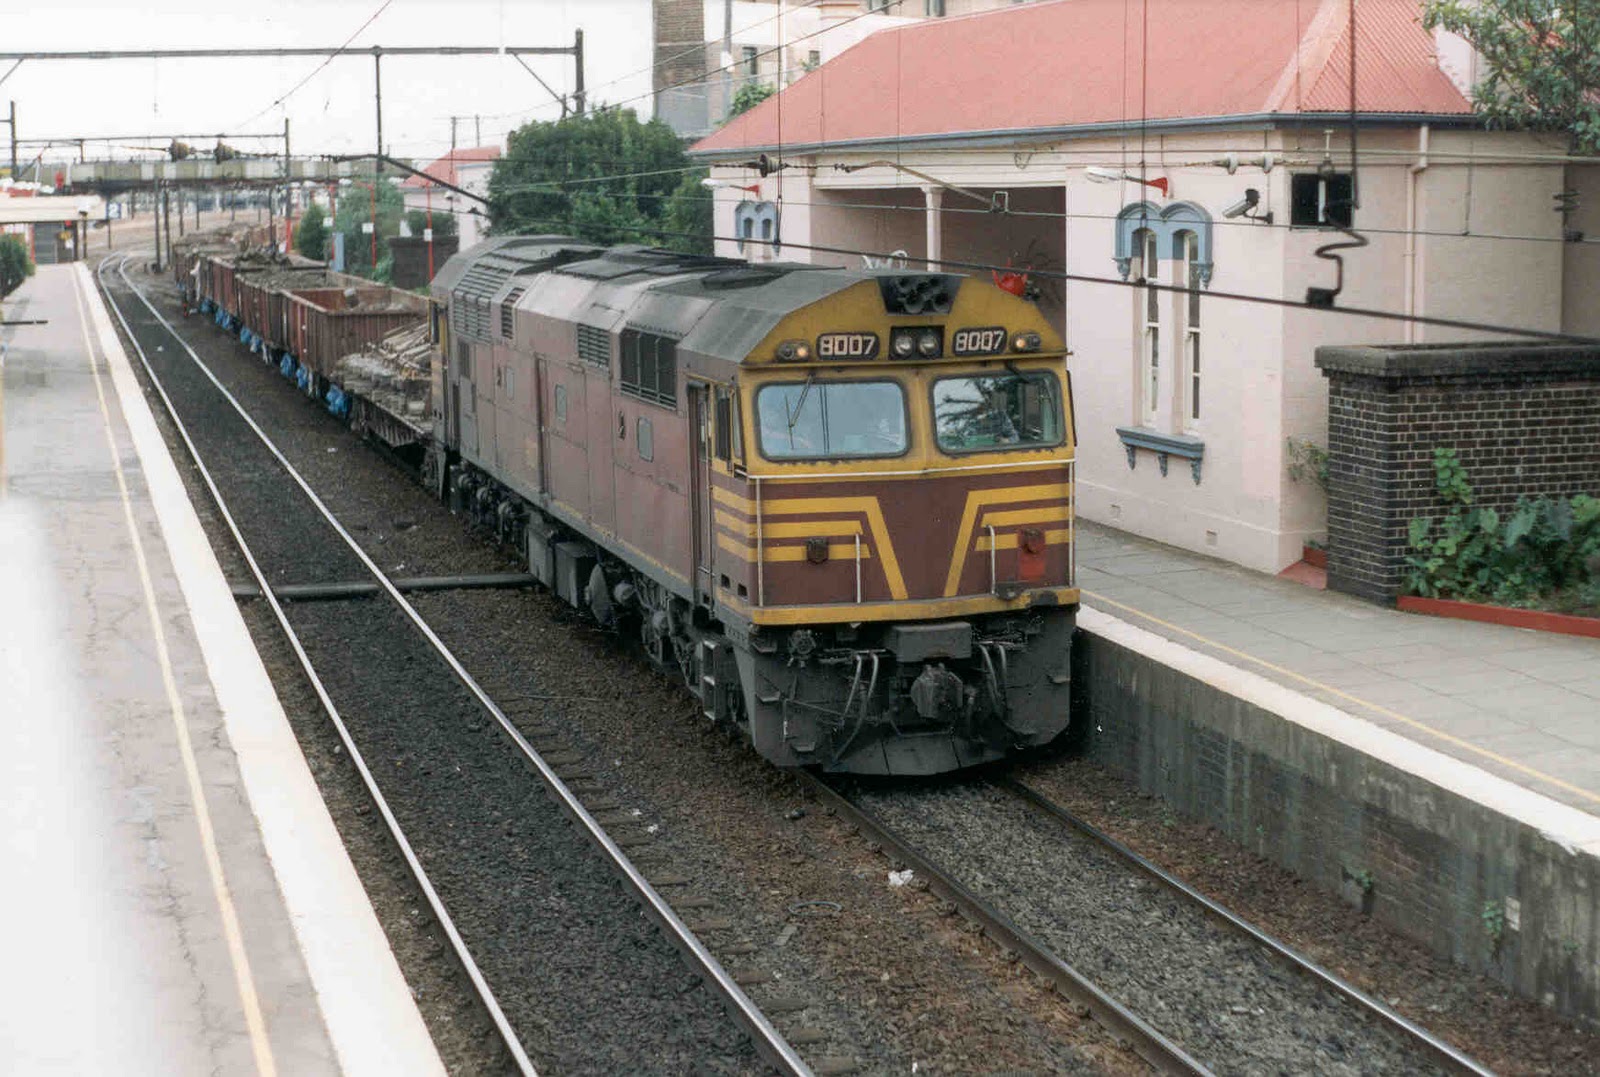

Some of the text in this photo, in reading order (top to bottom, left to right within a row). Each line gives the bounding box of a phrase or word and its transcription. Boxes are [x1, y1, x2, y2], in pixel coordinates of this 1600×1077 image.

[109, 202, 119, 218] 2
[820, 334, 876, 356] 8007
[955, 330, 1005, 351] 8007
